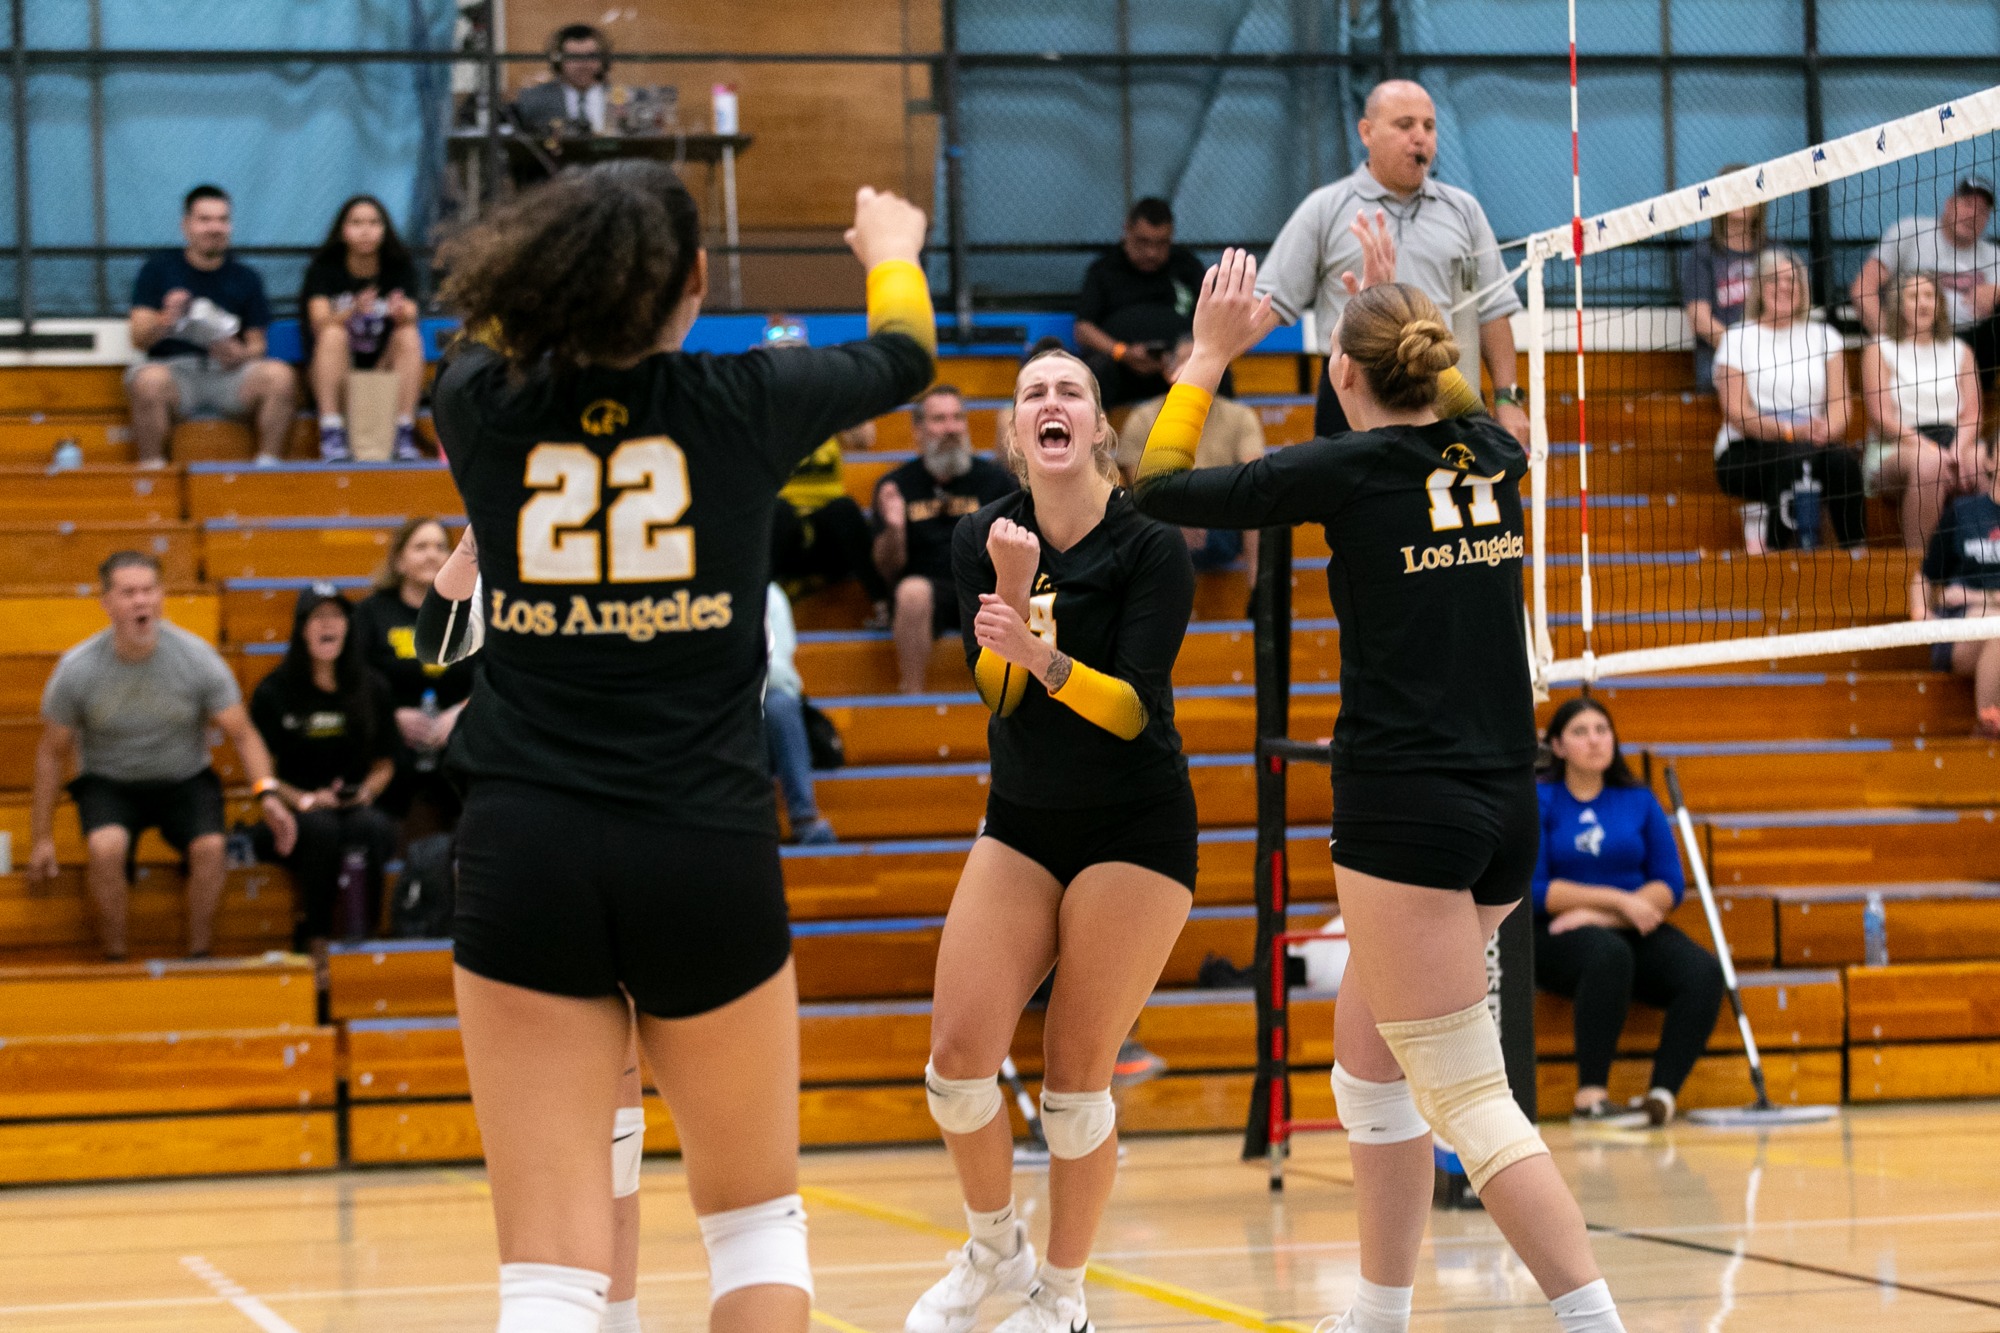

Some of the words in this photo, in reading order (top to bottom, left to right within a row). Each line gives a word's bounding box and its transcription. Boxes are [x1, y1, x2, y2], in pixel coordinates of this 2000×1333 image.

[516, 434, 697, 585] 22
[1400, 544, 1455, 574] Los
[491, 588, 558, 635] Los
[560, 588, 734, 642] Angeles
